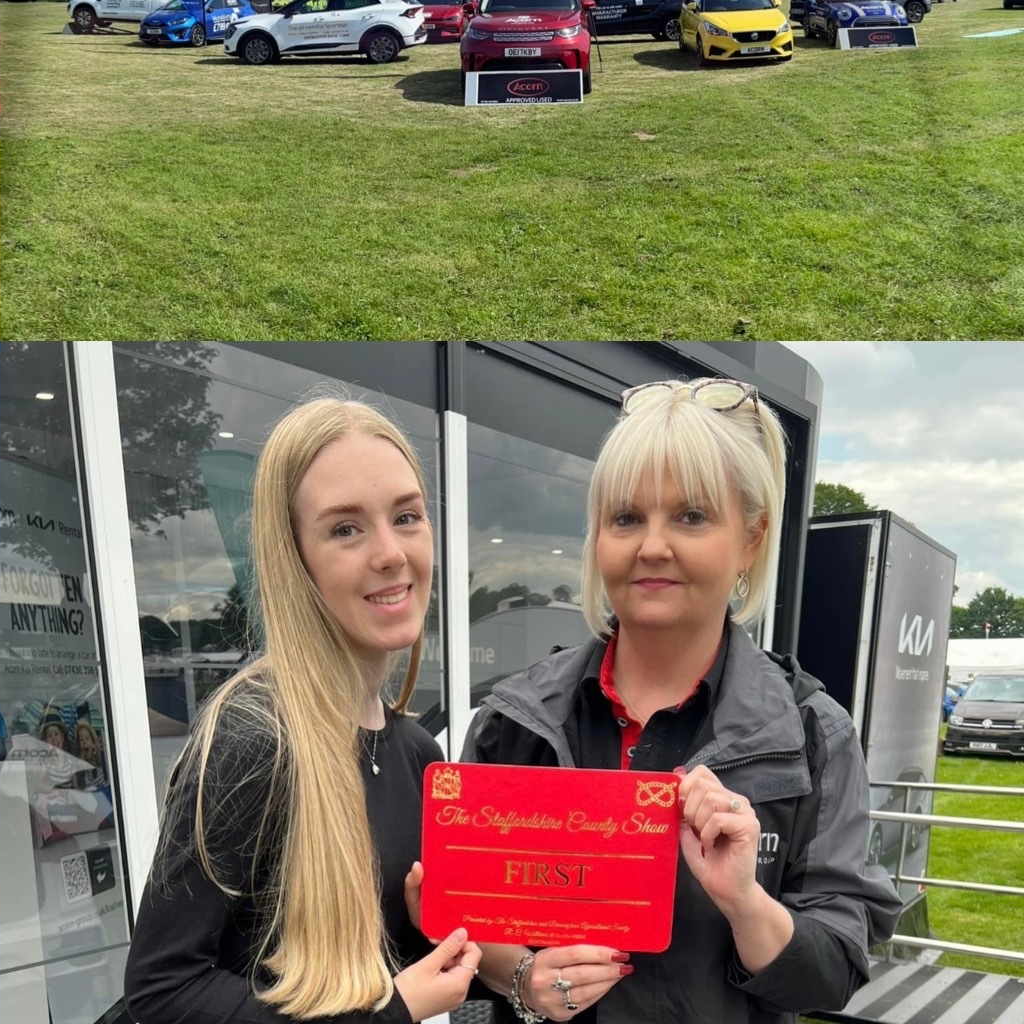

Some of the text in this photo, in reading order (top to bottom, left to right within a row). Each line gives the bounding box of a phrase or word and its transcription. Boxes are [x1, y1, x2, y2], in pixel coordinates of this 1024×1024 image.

[513, 80, 544, 91] Acorn
[27, 513, 55, 531] KIA
[11, 603, 84, 636] ANYTHING?
[898, 610, 934, 657] KIA
[436, 805, 670, 839] The Staffordshire County Show
[504, 860, 592, 888] FIRST
